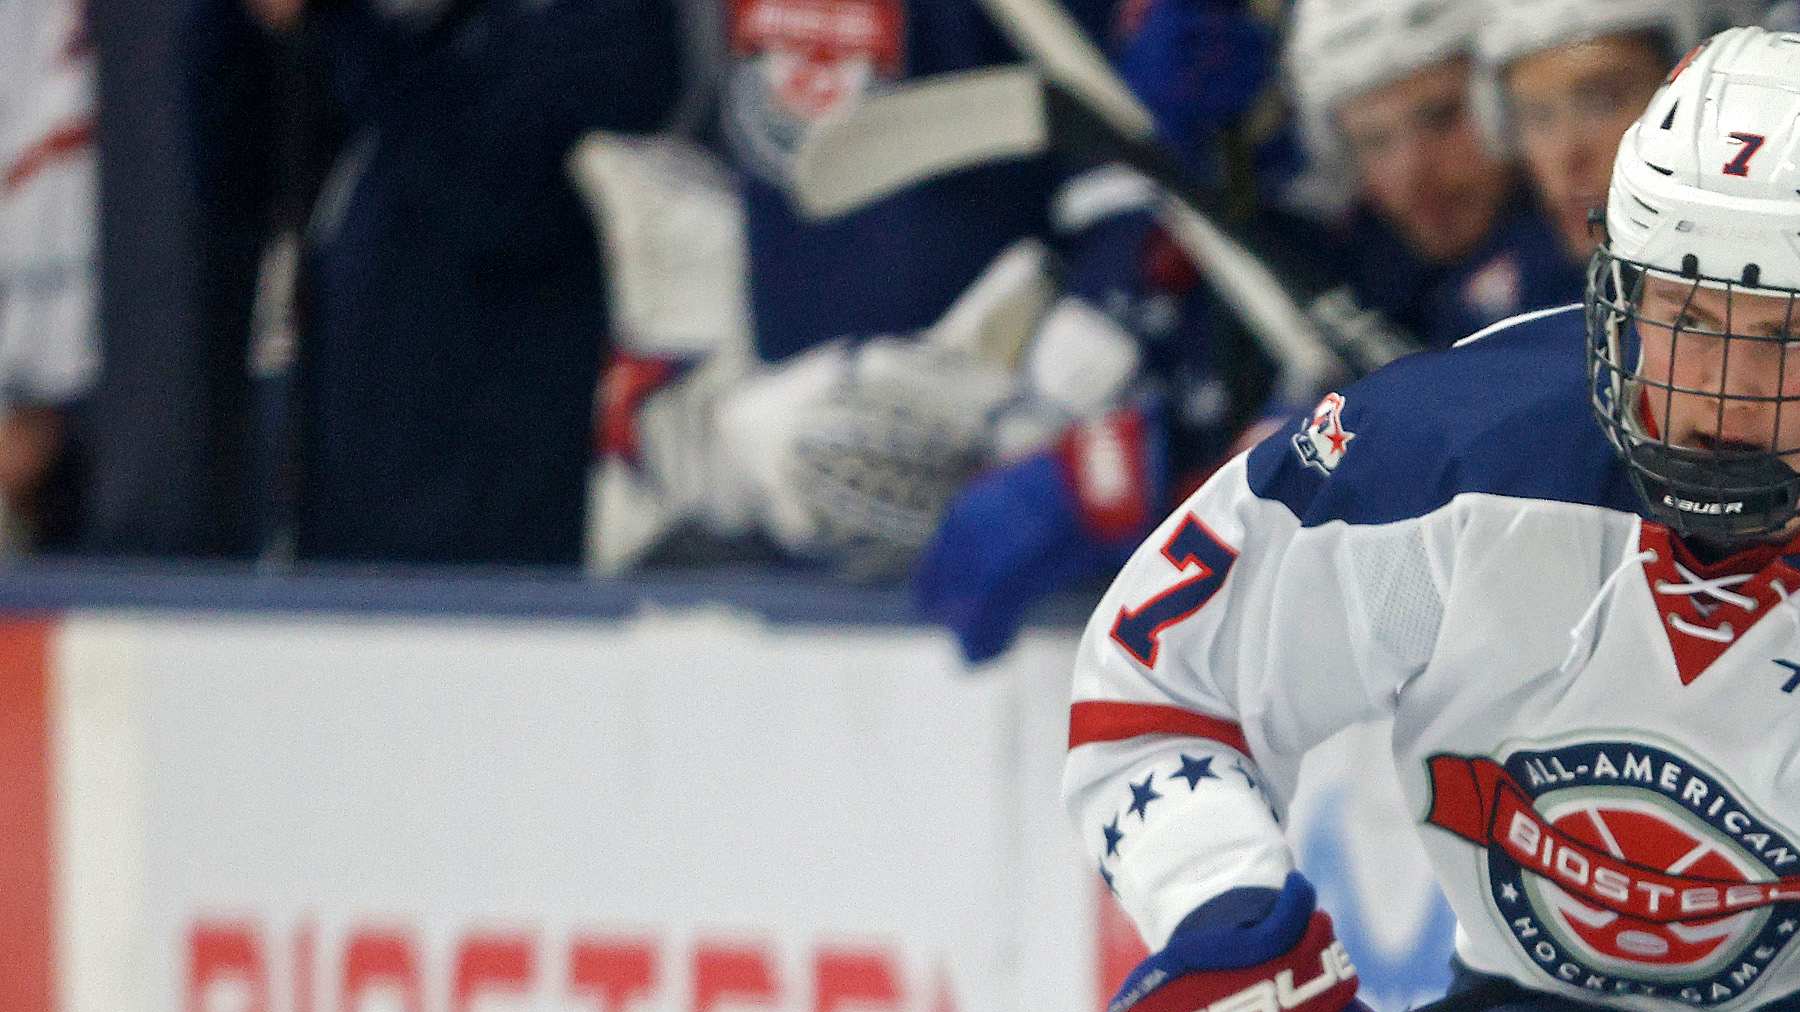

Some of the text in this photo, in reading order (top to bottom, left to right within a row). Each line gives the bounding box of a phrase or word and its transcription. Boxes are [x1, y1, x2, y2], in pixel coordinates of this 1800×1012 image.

[1722, 131, 1766, 177] 7
[1110, 511, 1239, 669] 7
[1527, 751, 1798, 866] ALL-AMERICAN
